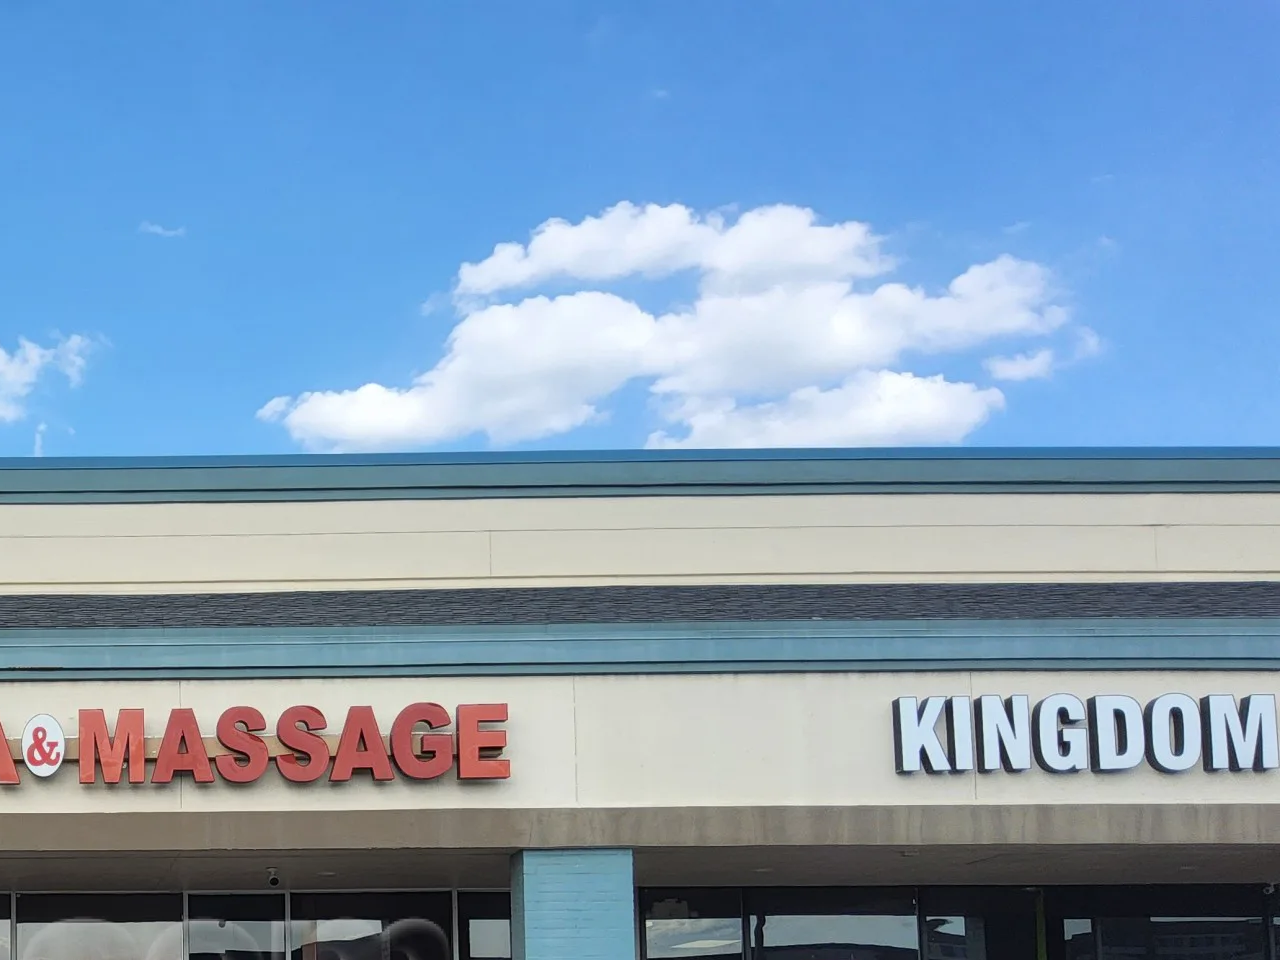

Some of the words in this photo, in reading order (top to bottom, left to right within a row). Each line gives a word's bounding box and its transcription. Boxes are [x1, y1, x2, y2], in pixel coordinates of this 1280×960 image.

[26, 727, 66, 766] &
[78, 702, 512, 784] MASSAGE
[893, 692, 1279, 774] KINGDOM
